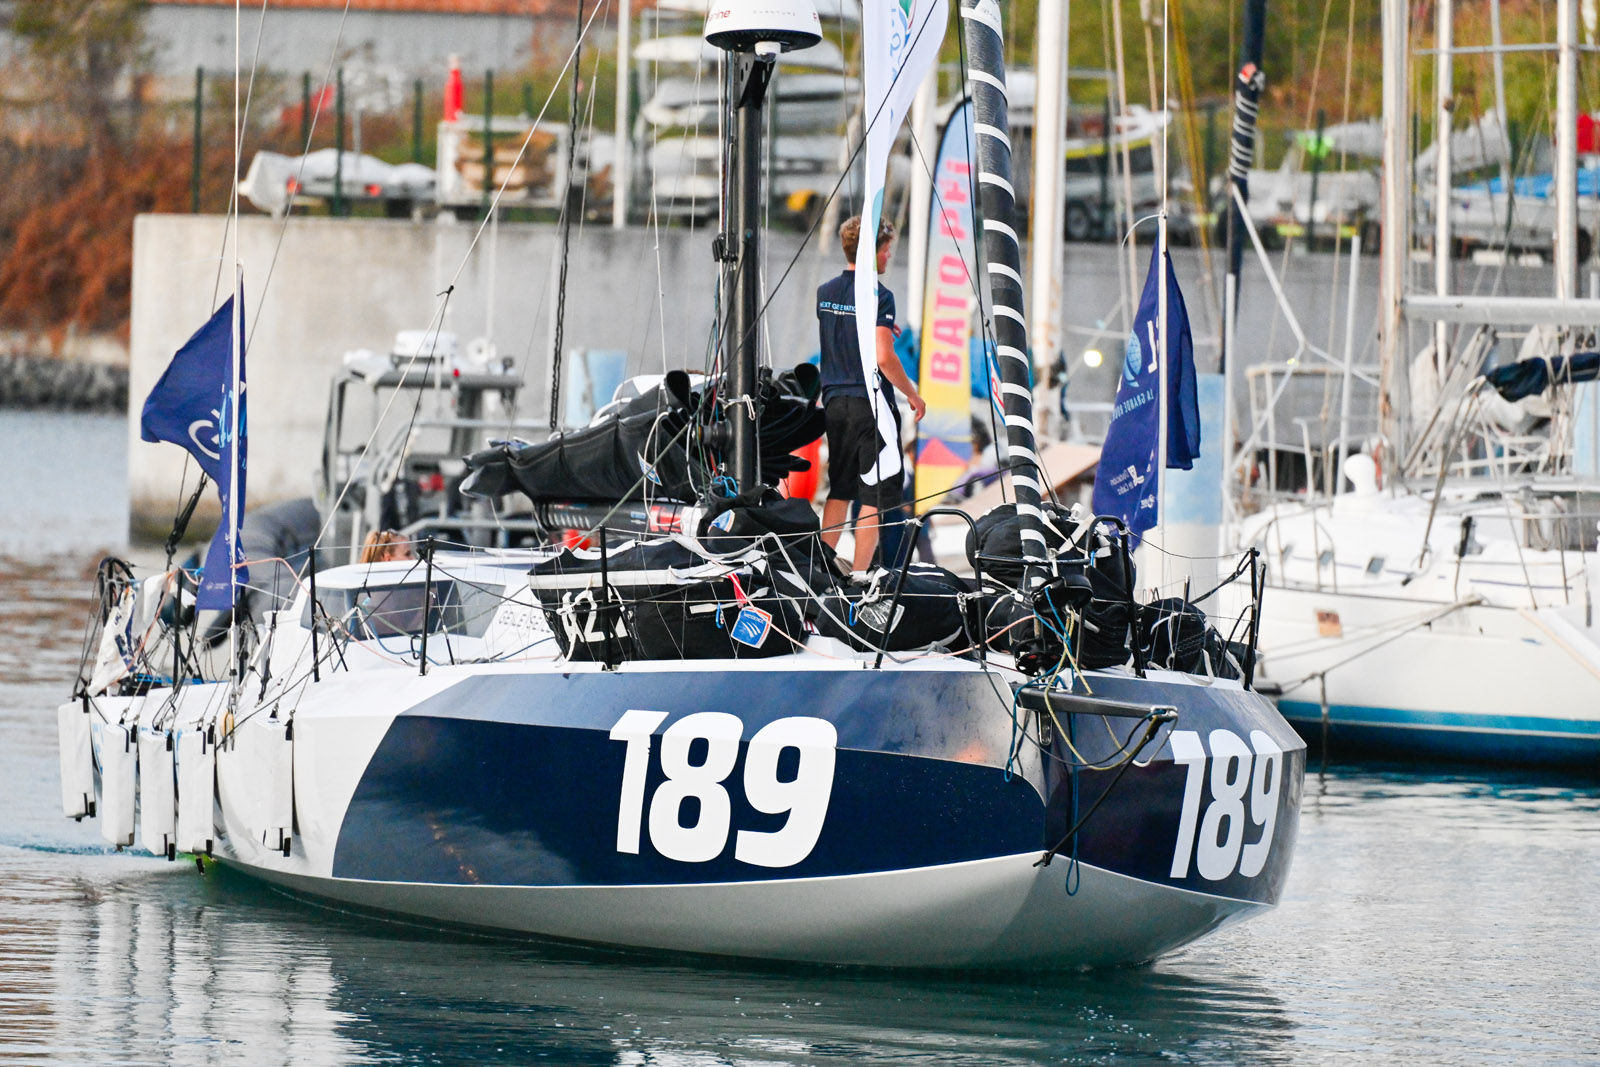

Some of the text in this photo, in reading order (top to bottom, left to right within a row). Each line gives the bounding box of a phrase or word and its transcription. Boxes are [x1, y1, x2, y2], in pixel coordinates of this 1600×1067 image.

[930, 255, 969, 384] BATO
[609, 709, 838, 868] 189
[1167, 728, 1283, 881] 189
